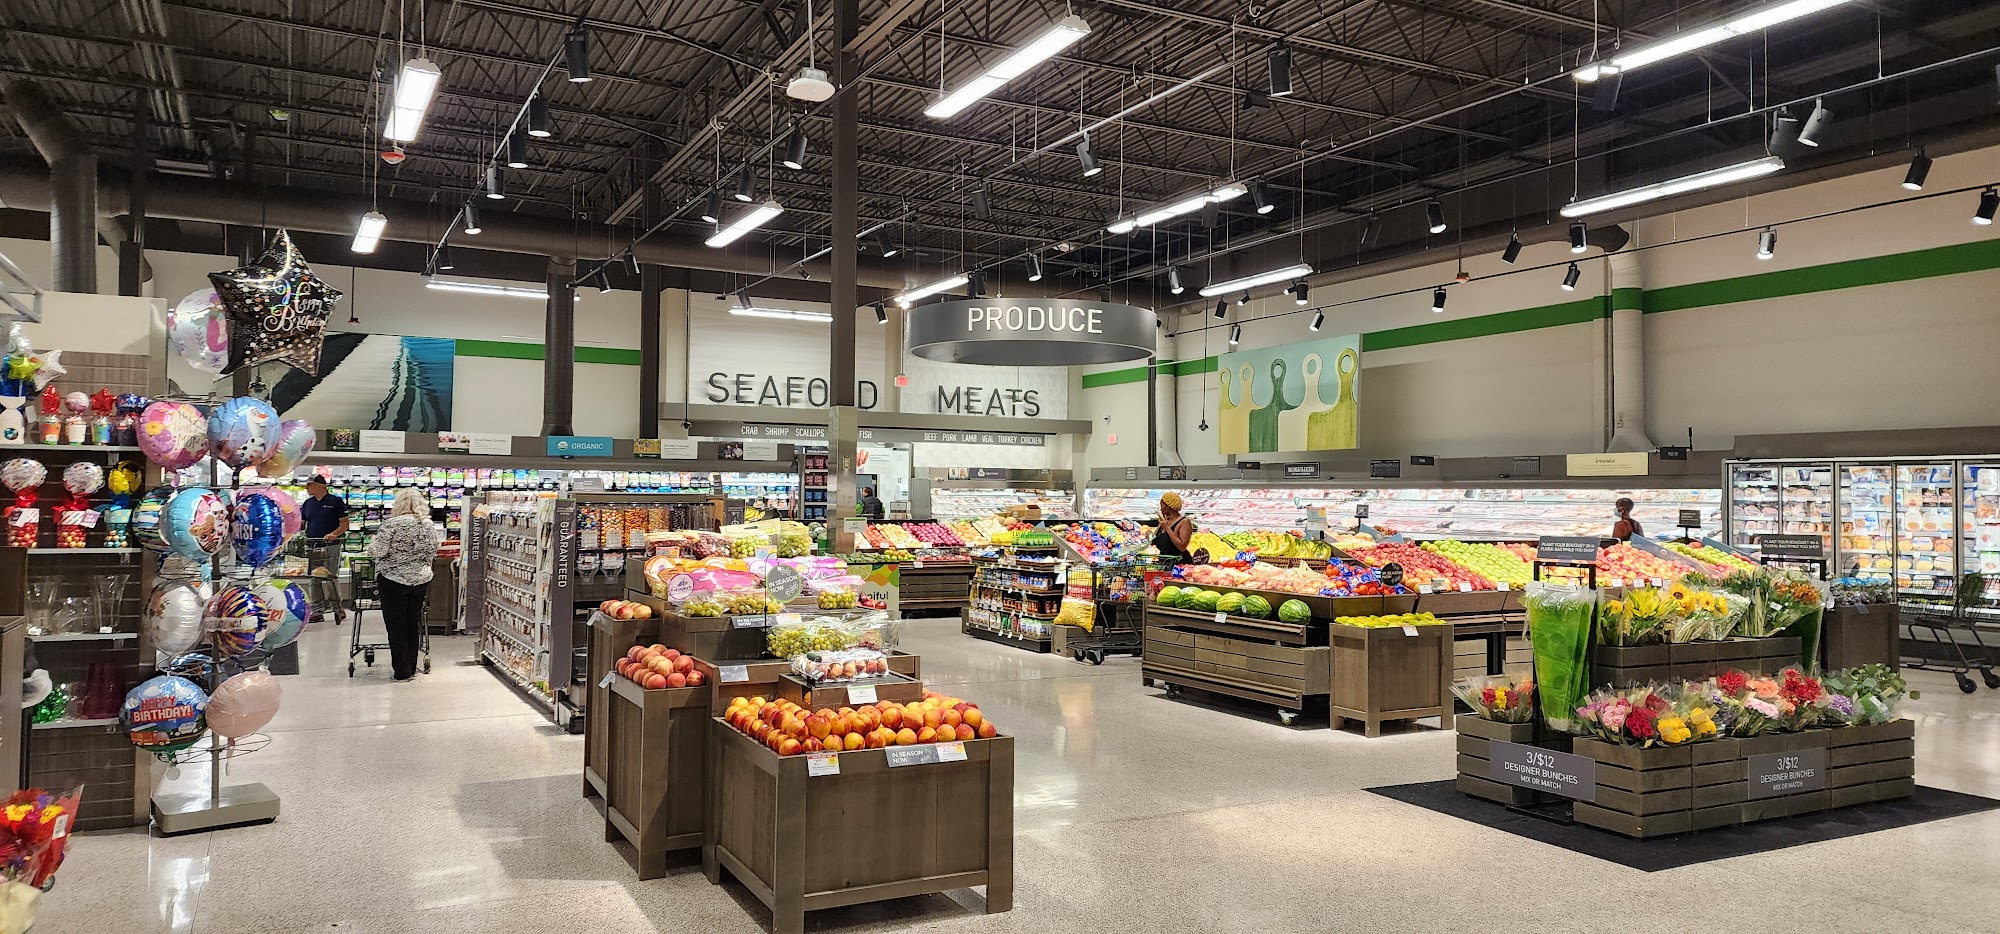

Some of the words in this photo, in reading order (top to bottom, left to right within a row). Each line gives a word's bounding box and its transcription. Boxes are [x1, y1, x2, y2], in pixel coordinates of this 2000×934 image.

[968, 306, 1103, 334] PRODUCE
[708, 371, 878, 410] SEAFOD
[938, 385, 1041, 417] MEATS
[741, 425, 759, 435] CRAB
[765, 427, 790, 437] SHRIMP
[795, 428, 825, 438] SCALLOPS
[858, 430, 872, 439] FISH
[924, 432, 938, 441] BEEF
[942, 433, 957, 442] PORK
[962, 434, 977, 443] LAMB
[981, 434, 995, 443] VEAL
[998, 435, 1018, 444] TURKEY
[1020, 435, 1043, 445] CHICKEN
[571, 442, 604, 450] ORGANIC
[472, 516, 481, 560] UARANTEED
[557, 521, 570, 588] GUARANTEED
[775, 575, 798, 586] SEASON
[770, 585, 784, 594] NOW
[140, 696, 176, 710] HAPPY
[133, 705, 192, 722] BIRTHDAY!
[899, 750, 924, 758] SEASON
[1526, 751, 1555, 769] 3/$12
[1777, 756, 1799, 771] 3/$12
[1504, 761, 1541, 776] DESIGNER
[1542, 769, 1579, 785] BUNCHES
[1760, 772, 1788, 784] DESIGNER
[1789, 769, 1815, 780] BUNCHES
[1520, 775, 1531, 783] MIX
[1531, 777, 1541, 785] OR
[1541, 779, 1562, 790] MATCH
[1781, 782, 1788, 790] OR
